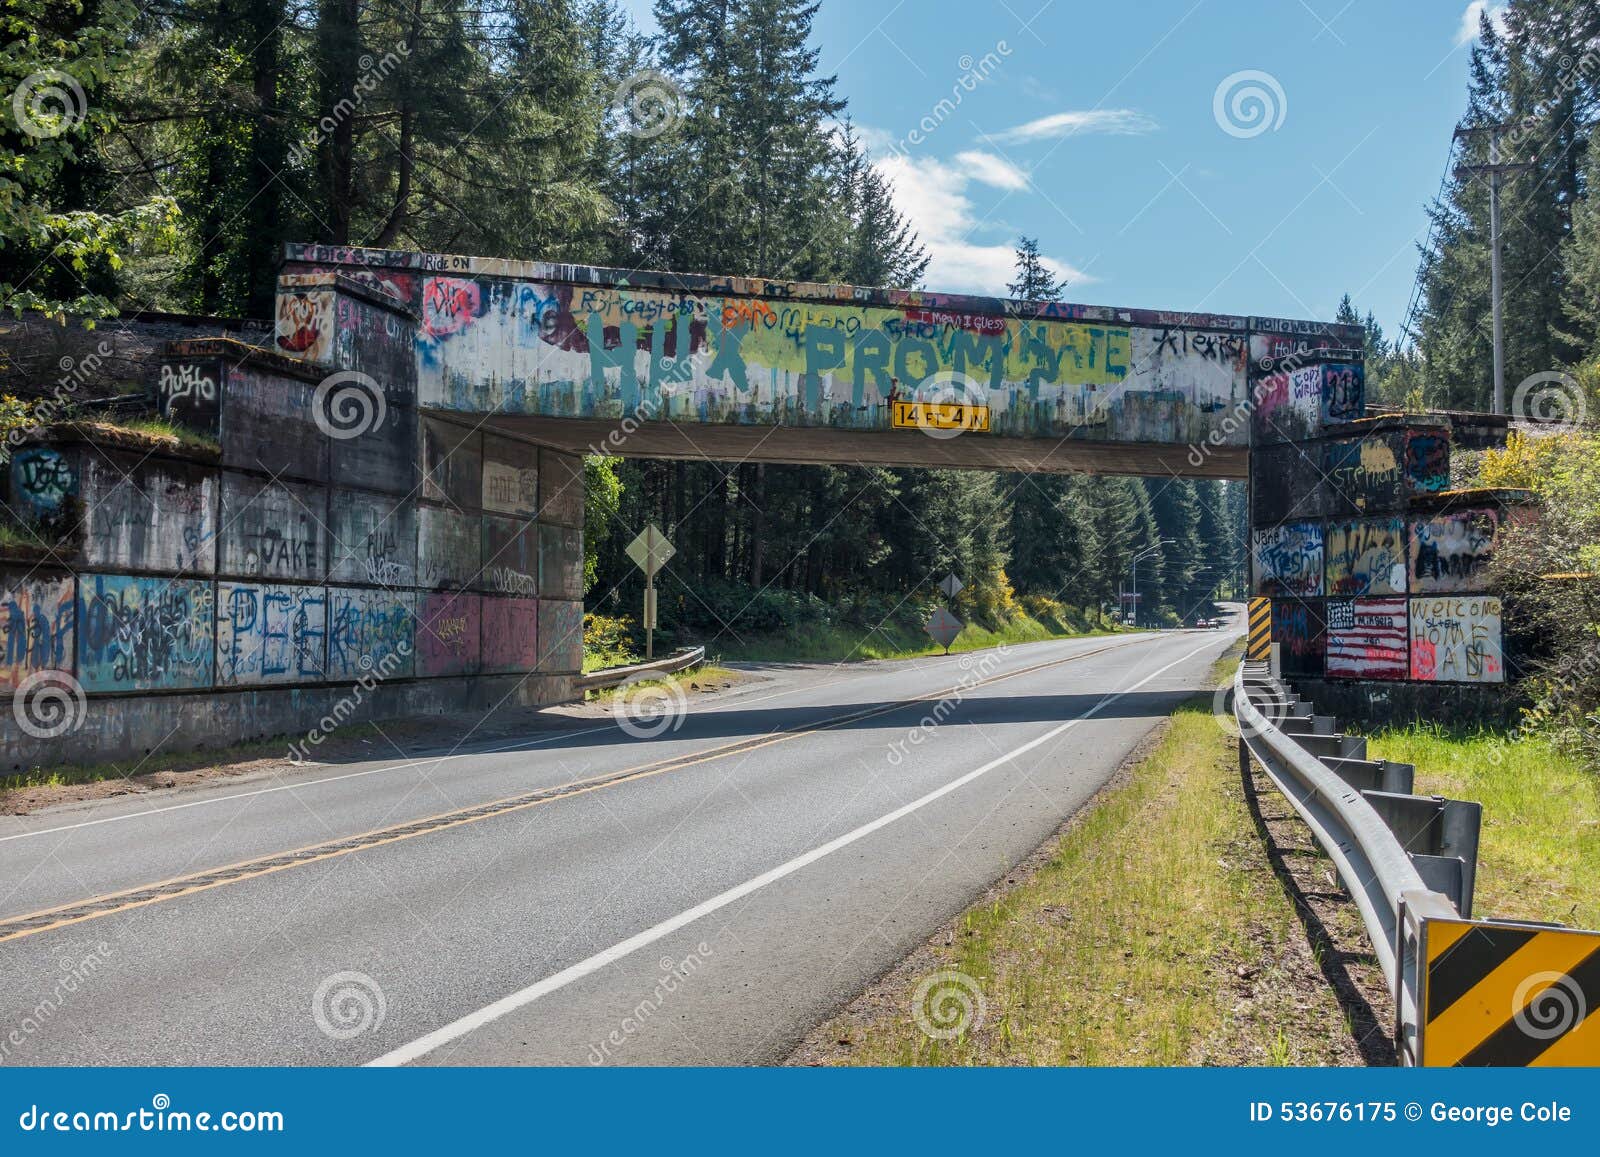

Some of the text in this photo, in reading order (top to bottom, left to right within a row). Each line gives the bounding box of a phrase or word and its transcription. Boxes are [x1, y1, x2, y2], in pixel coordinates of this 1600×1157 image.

[425, 255, 449, 270] Ride
[453, 257, 470, 269] ON
[900, 405, 984, 428] 14 FT 4 IN
